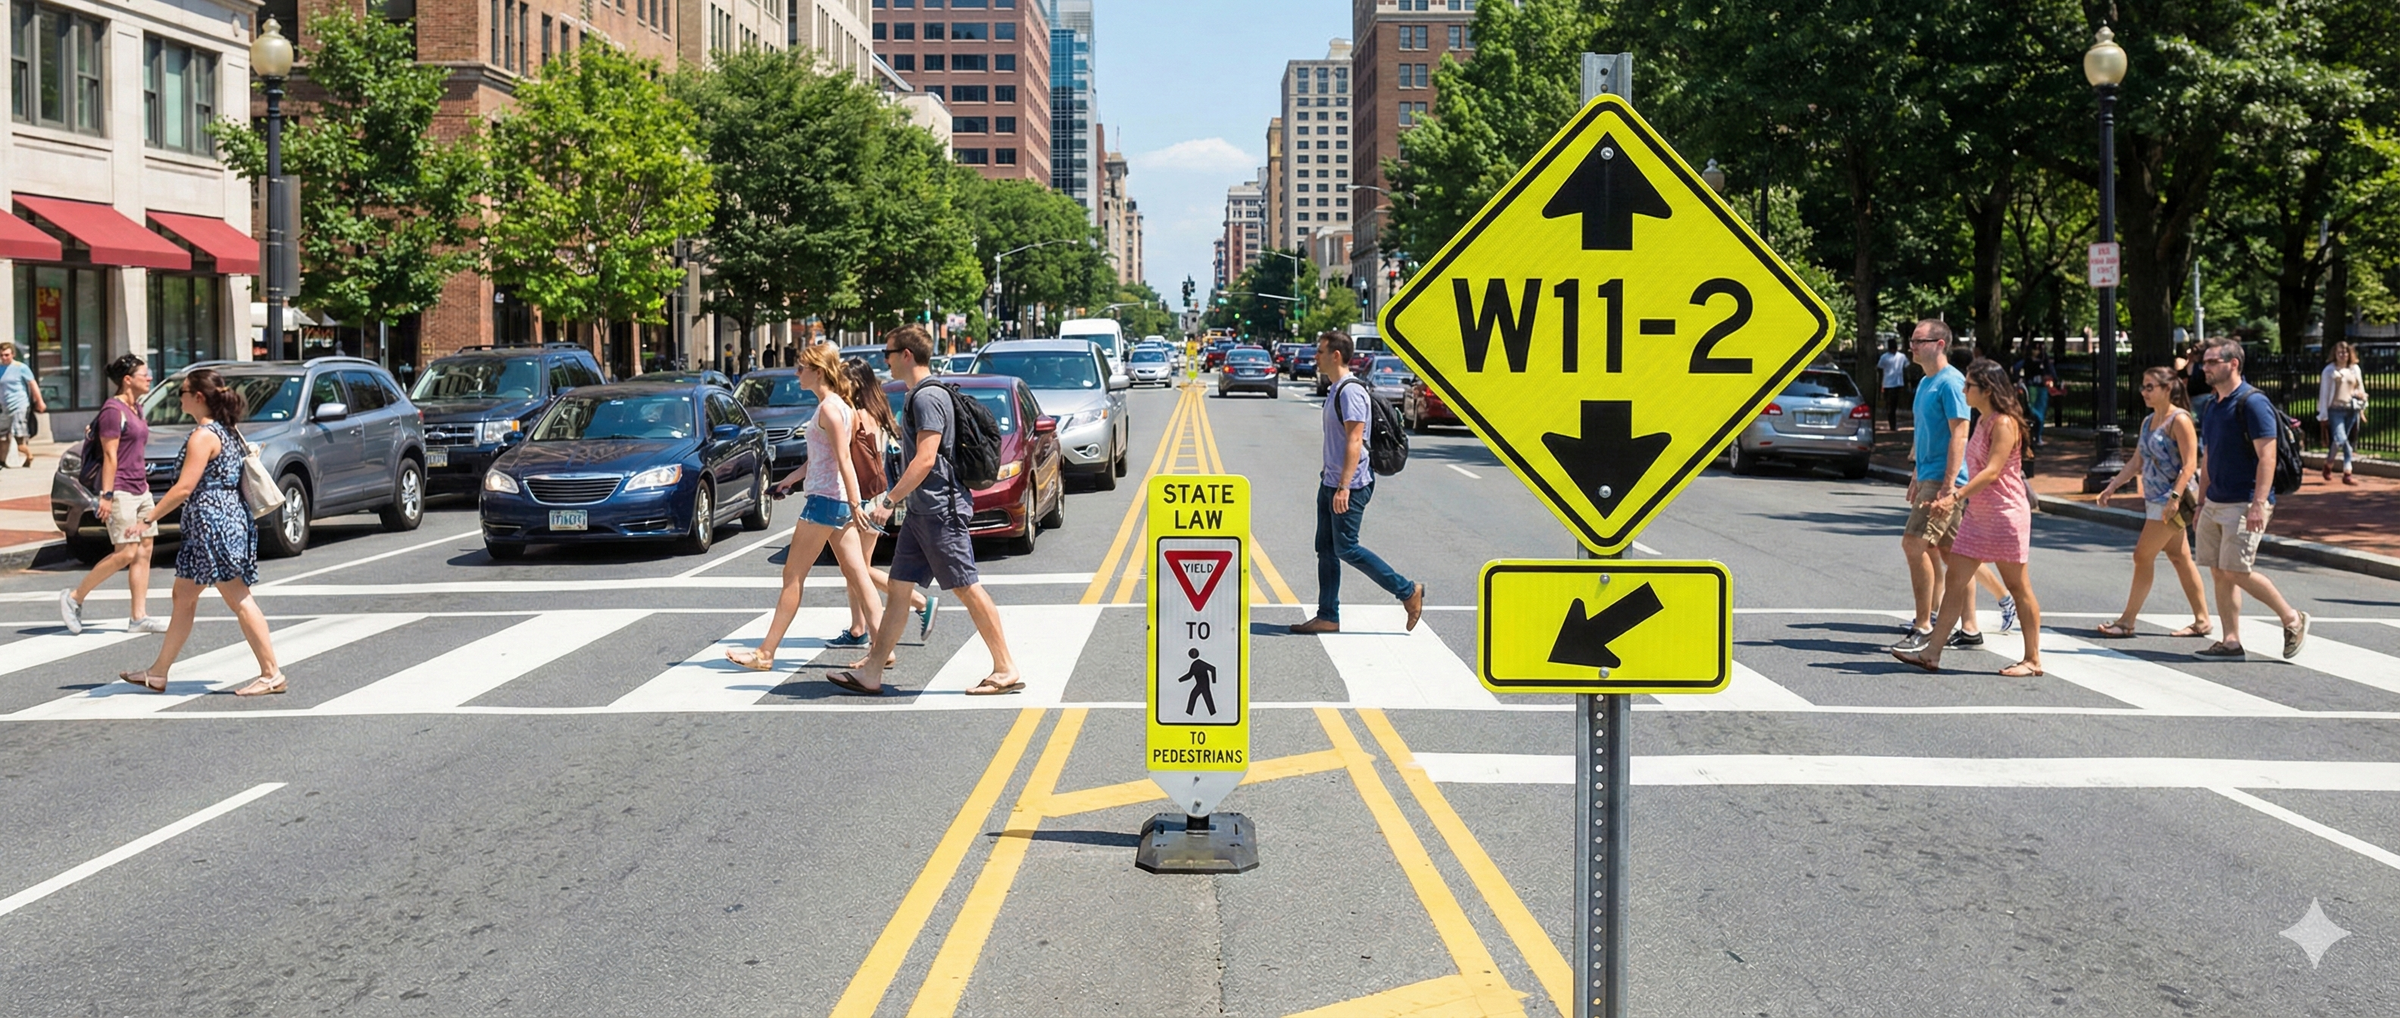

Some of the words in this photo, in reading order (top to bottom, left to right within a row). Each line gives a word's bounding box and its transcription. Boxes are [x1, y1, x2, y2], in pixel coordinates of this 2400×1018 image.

[1451, 277, 1754, 374] W11-2
[1163, 483, 1235, 504] STATE
[1174, 509, 1223, 530] LAW
[1183, 563, 1214, 574] YIELD
[1185, 621, 1211, 640] TO
[1189, 731, 1206, 745] TO
[1153, 749, 1243, 764] PEDESTRIANS
